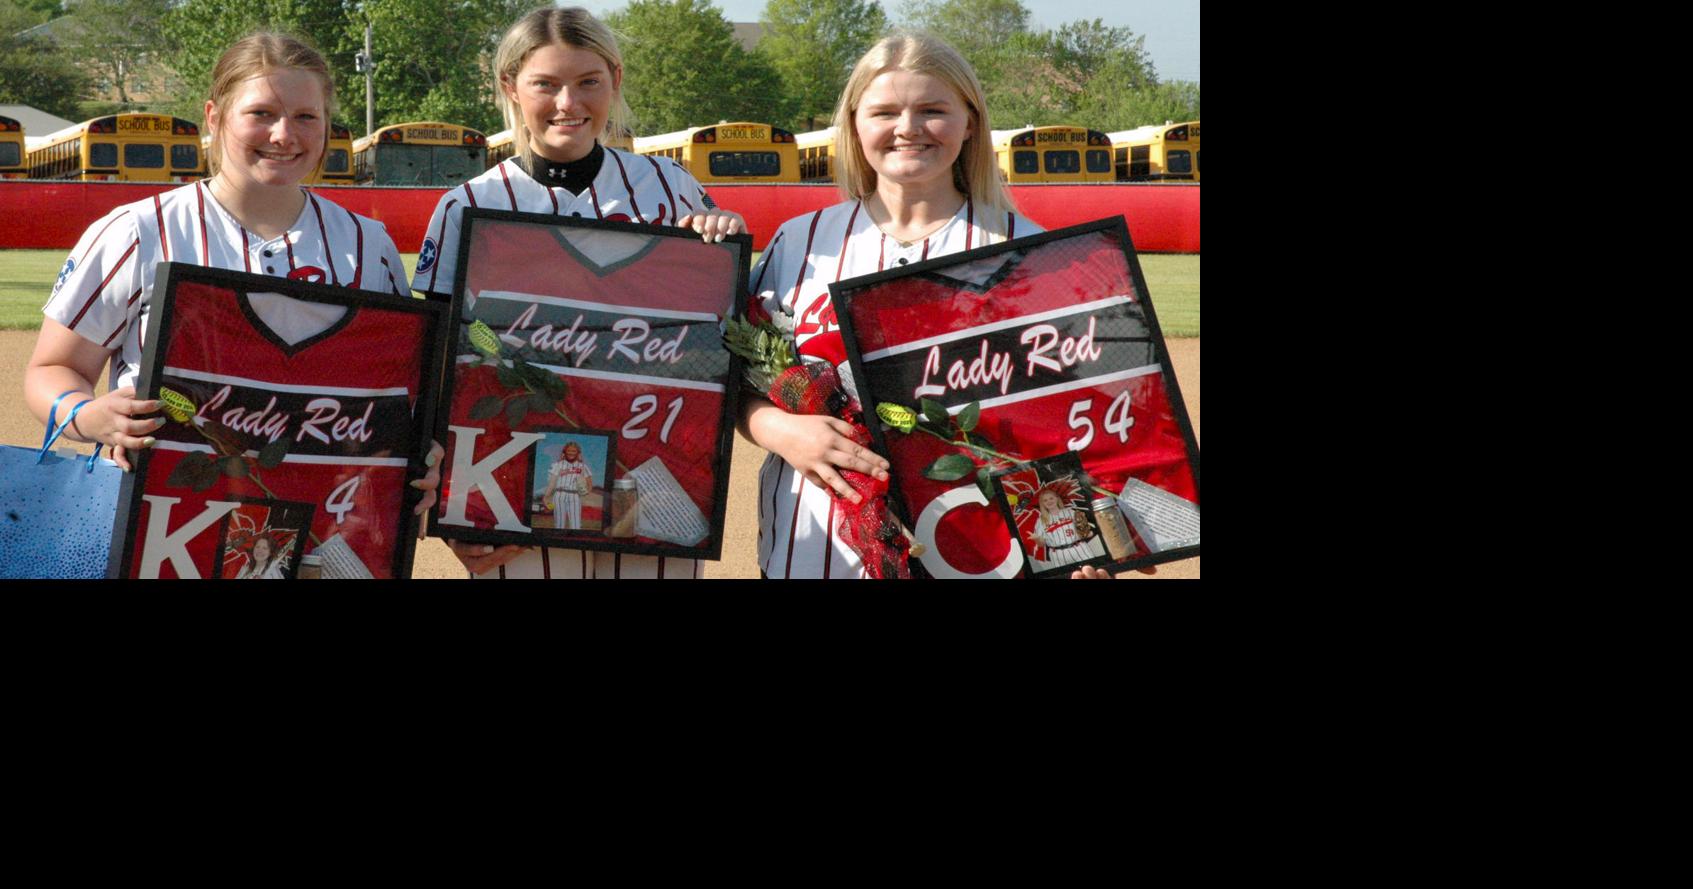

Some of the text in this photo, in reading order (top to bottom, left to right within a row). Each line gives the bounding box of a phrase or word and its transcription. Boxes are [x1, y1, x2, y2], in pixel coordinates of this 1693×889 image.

[119, 119, 170, 131] SCHOOL BUS
[406, 127, 458, 140] SCHOOL BUS
[721, 128, 766, 139] SCHOOL BUS
[1038, 131, 1086, 142] SCHOOL BUS
[499, 303, 689, 368] Lady Red
[794, 293, 839, 338] La
[914, 316, 1102, 399] Lady Red
[195, 385, 375, 445] Lady Red
[621, 394, 684, 444] 21
[1066, 390, 1135, 452] 54
[325, 476, 361, 525] 4
[438, 425, 546, 533] K
[139, 494, 241, 580] K
[914, 483, 1024, 580] C
